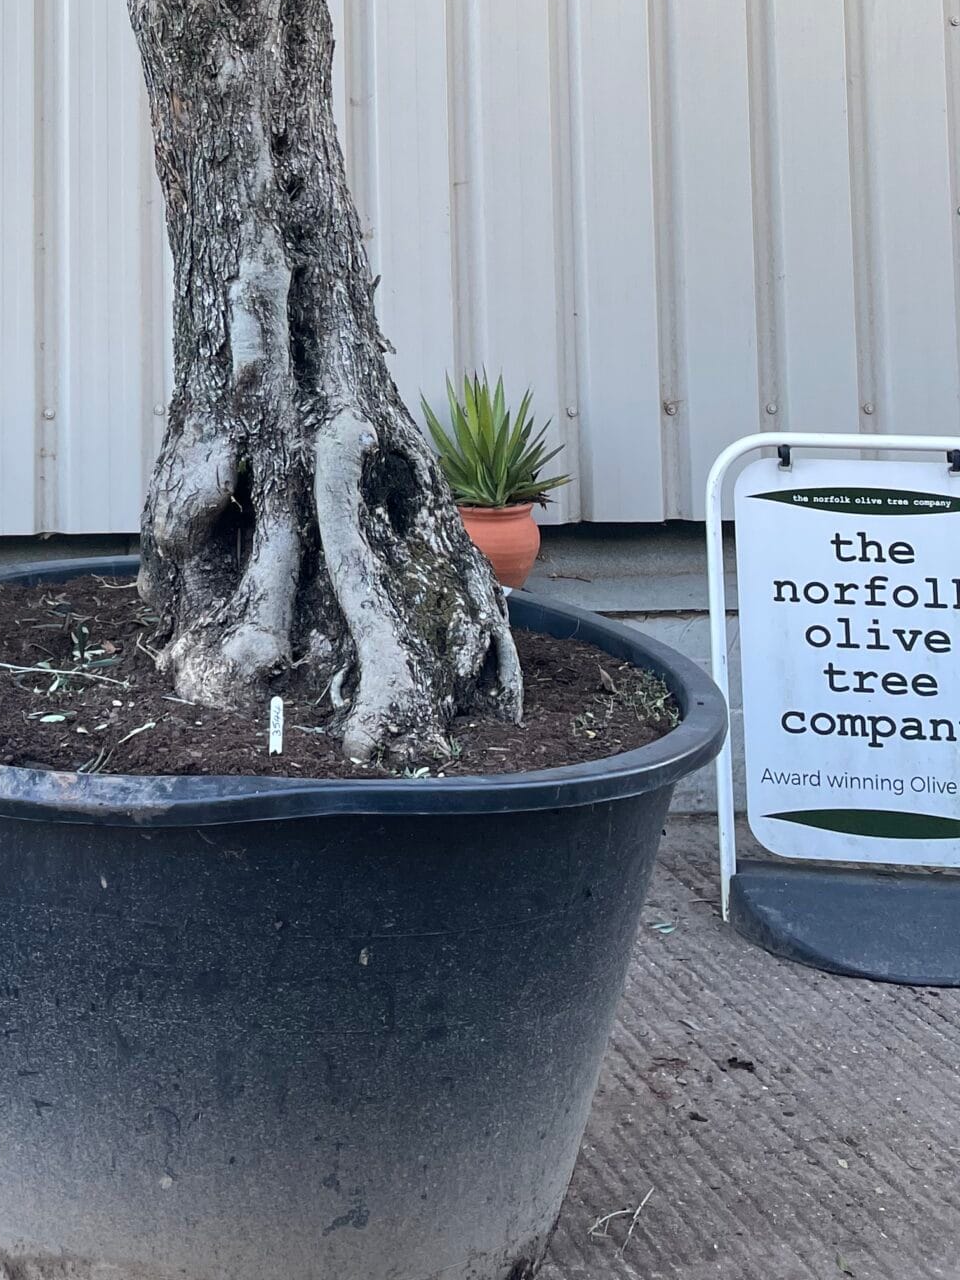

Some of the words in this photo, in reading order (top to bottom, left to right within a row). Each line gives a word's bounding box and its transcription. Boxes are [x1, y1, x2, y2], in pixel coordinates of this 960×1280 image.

[792, 494, 809, 503] the
[813, 495, 851, 505] norfolk
[855, 497, 882, 505] olive
[887, 498, 909, 506] tree
[913, 499, 952, 508] company
[830, 532, 915, 565] the
[805, 617, 952, 654] olive
[823, 662, 939, 697] tree
[781, 711, 960, 748] compan
[761, 768, 821, 787] Award
[827, 772, 904, 796] winning
[910, 776, 958, 795] Olive
